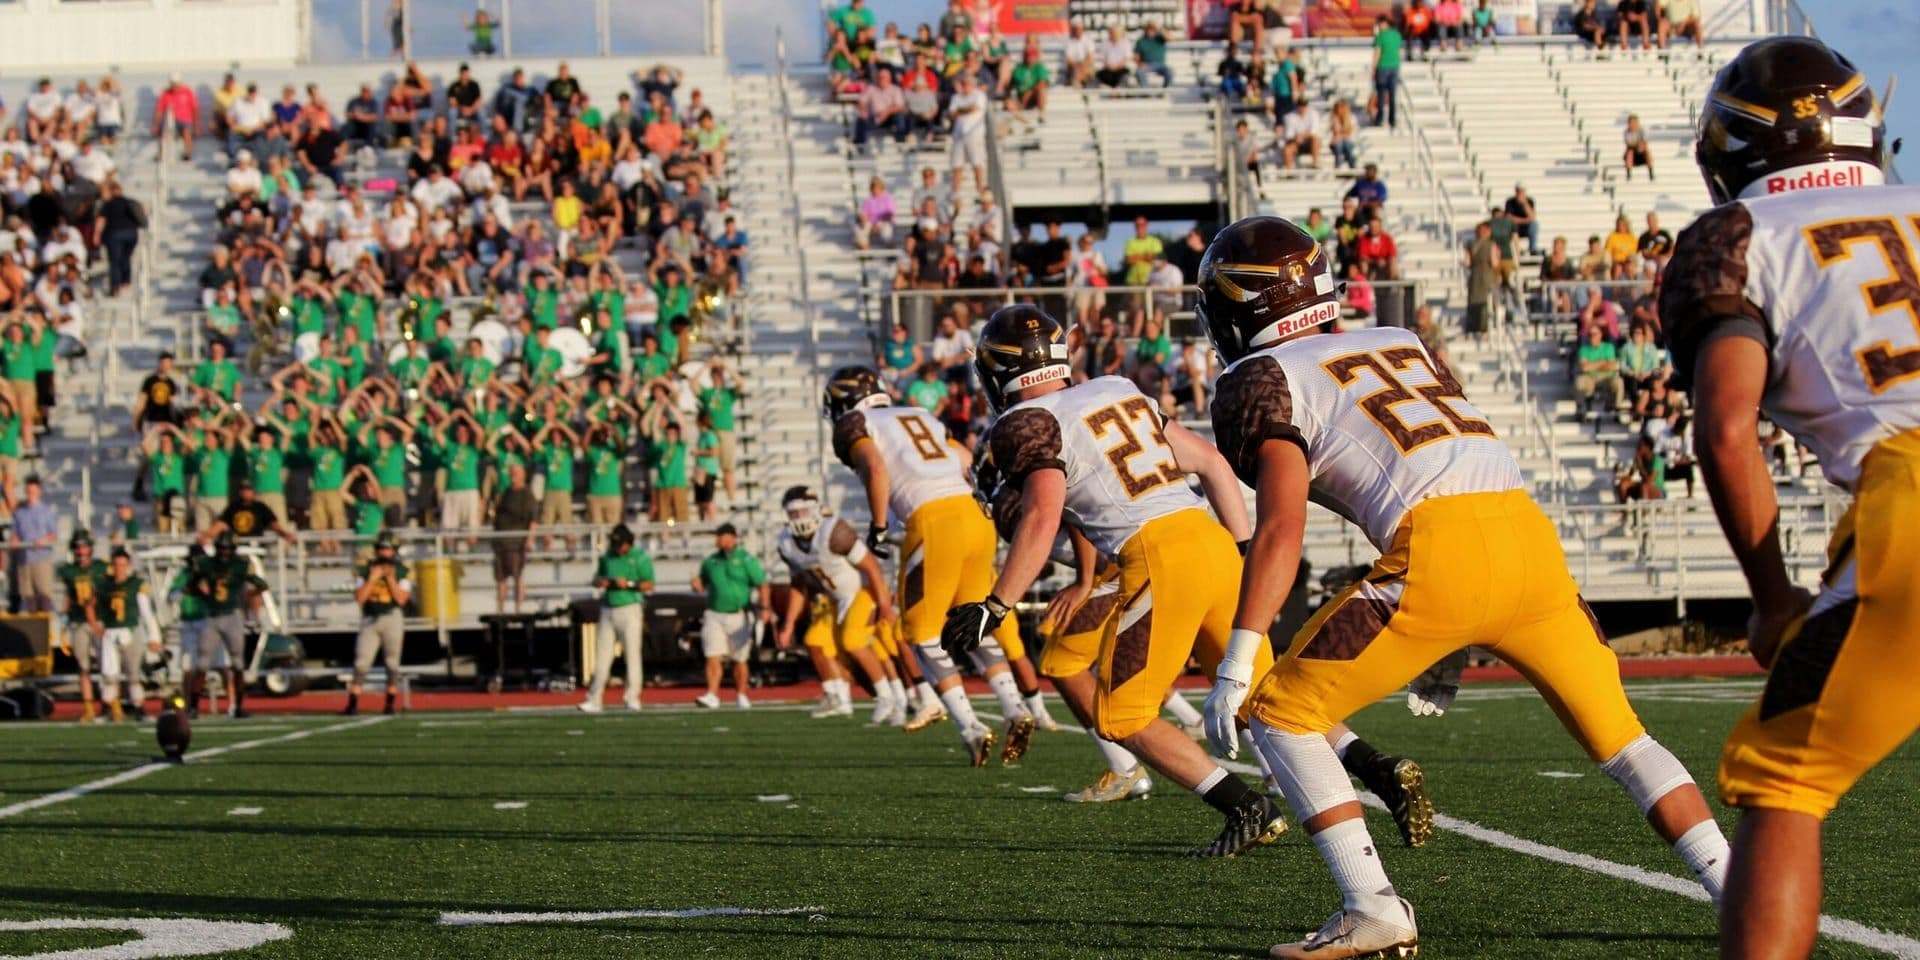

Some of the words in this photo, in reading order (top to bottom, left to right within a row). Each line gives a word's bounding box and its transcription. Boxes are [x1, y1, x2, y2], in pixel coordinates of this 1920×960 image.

[1791, 98, 1819, 118] 35
[1767, 167, 1863, 193] Riddell
[1277, 304, 1335, 336] Riddell
[1801, 215, 1920, 394] 3
[1026, 319, 1040, 329] 23
[1020, 367, 1065, 388] Riddell
[1320, 345, 1498, 456] 22
[896, 415, 948, 461] 8
[1083, 396, 1185, 499] 23
